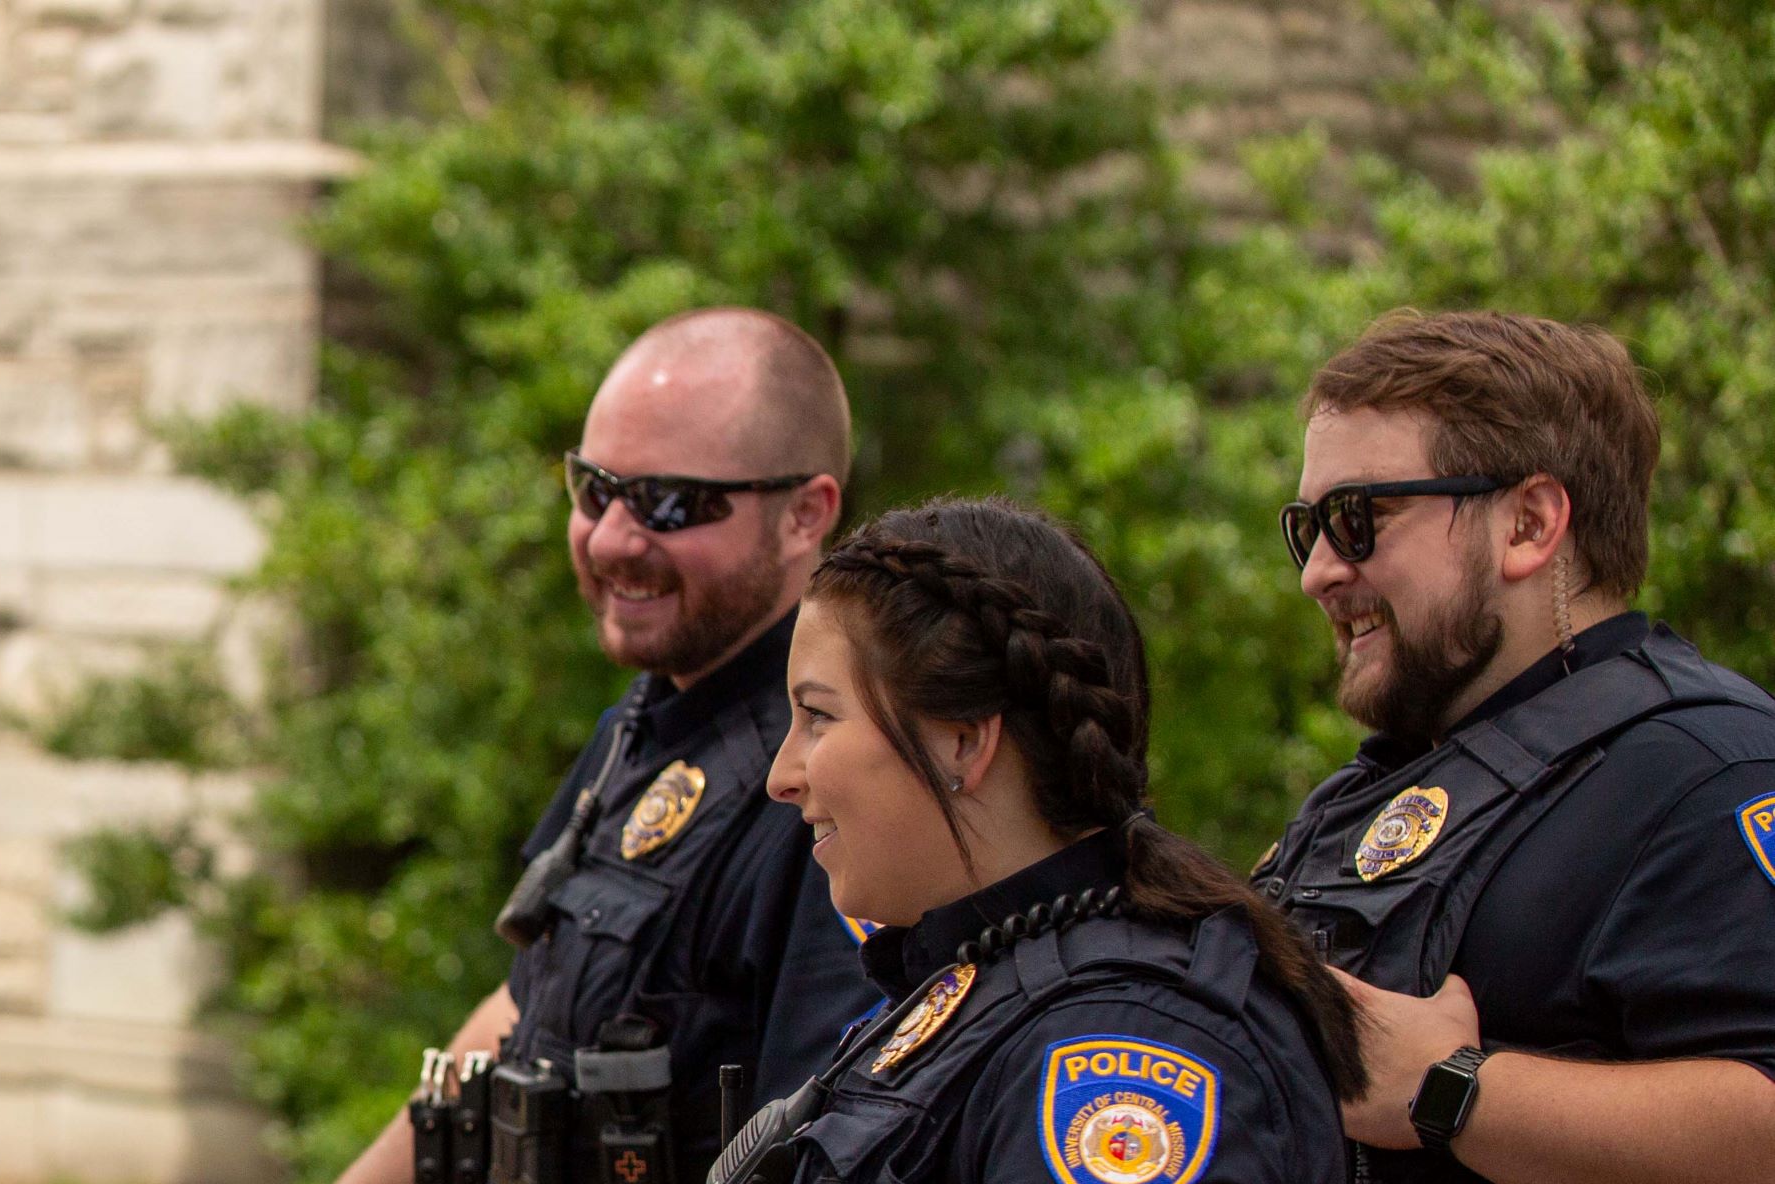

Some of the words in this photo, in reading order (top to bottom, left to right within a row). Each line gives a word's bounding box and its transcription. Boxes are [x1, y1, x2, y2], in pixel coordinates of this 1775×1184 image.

[1064, 1052, 1201, 1098] POLICE
[1064, 1102, 1096, 1169] UNIVERSITY
[1094, 1092, 1112, 1109] OF
[1113, 1091, 1171, 1119] CENTRAL
[1164, 1120, 1186, 1180] MISSOURI
